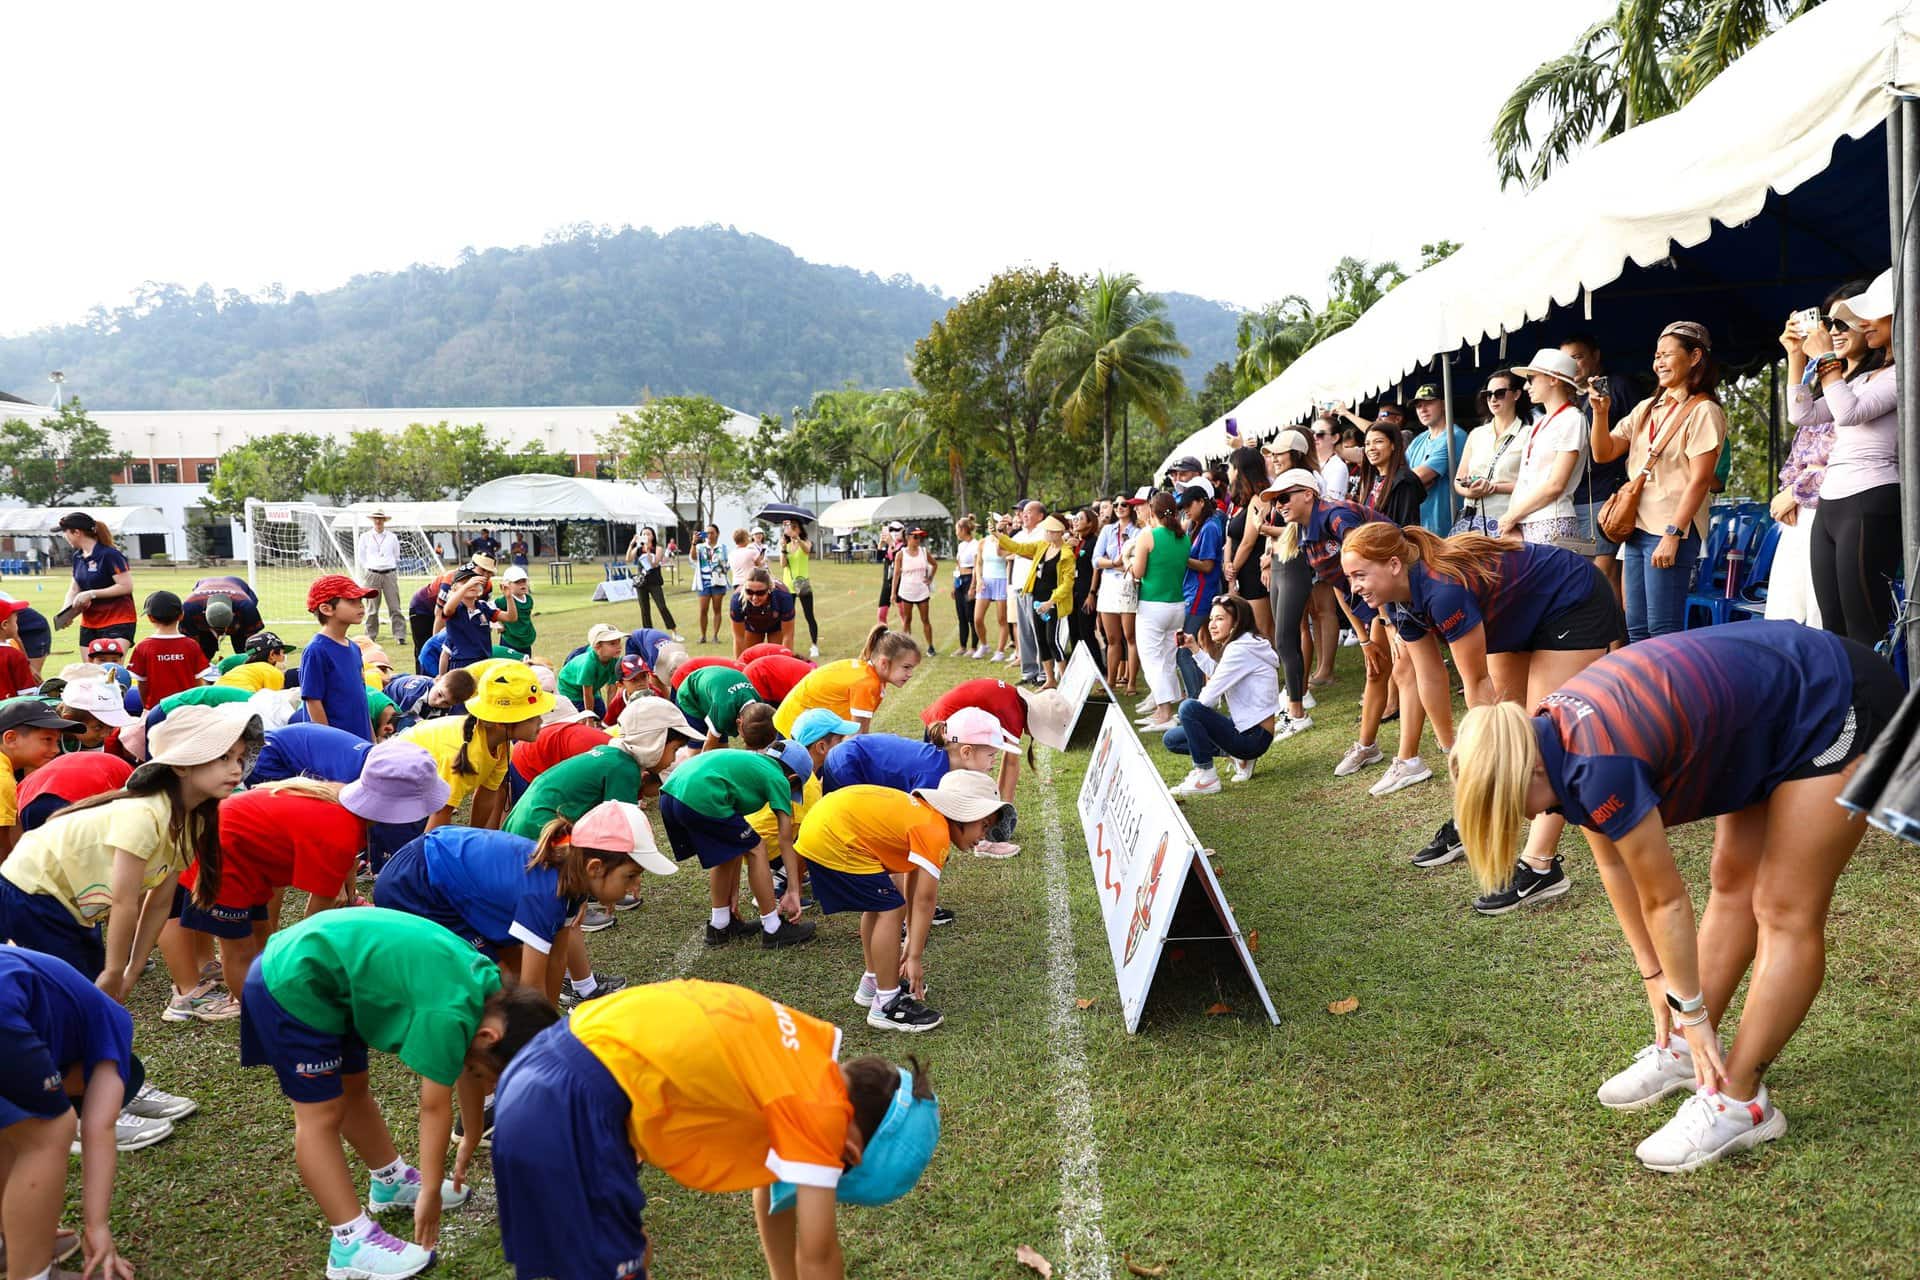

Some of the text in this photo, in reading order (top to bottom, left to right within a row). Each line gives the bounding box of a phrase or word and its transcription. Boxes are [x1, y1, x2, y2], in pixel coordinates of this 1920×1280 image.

[157, 653, 185, 662] TIGERS
[1112, 769, 1142, 857] British
[1591, 794, 1625, 825] BOVE
